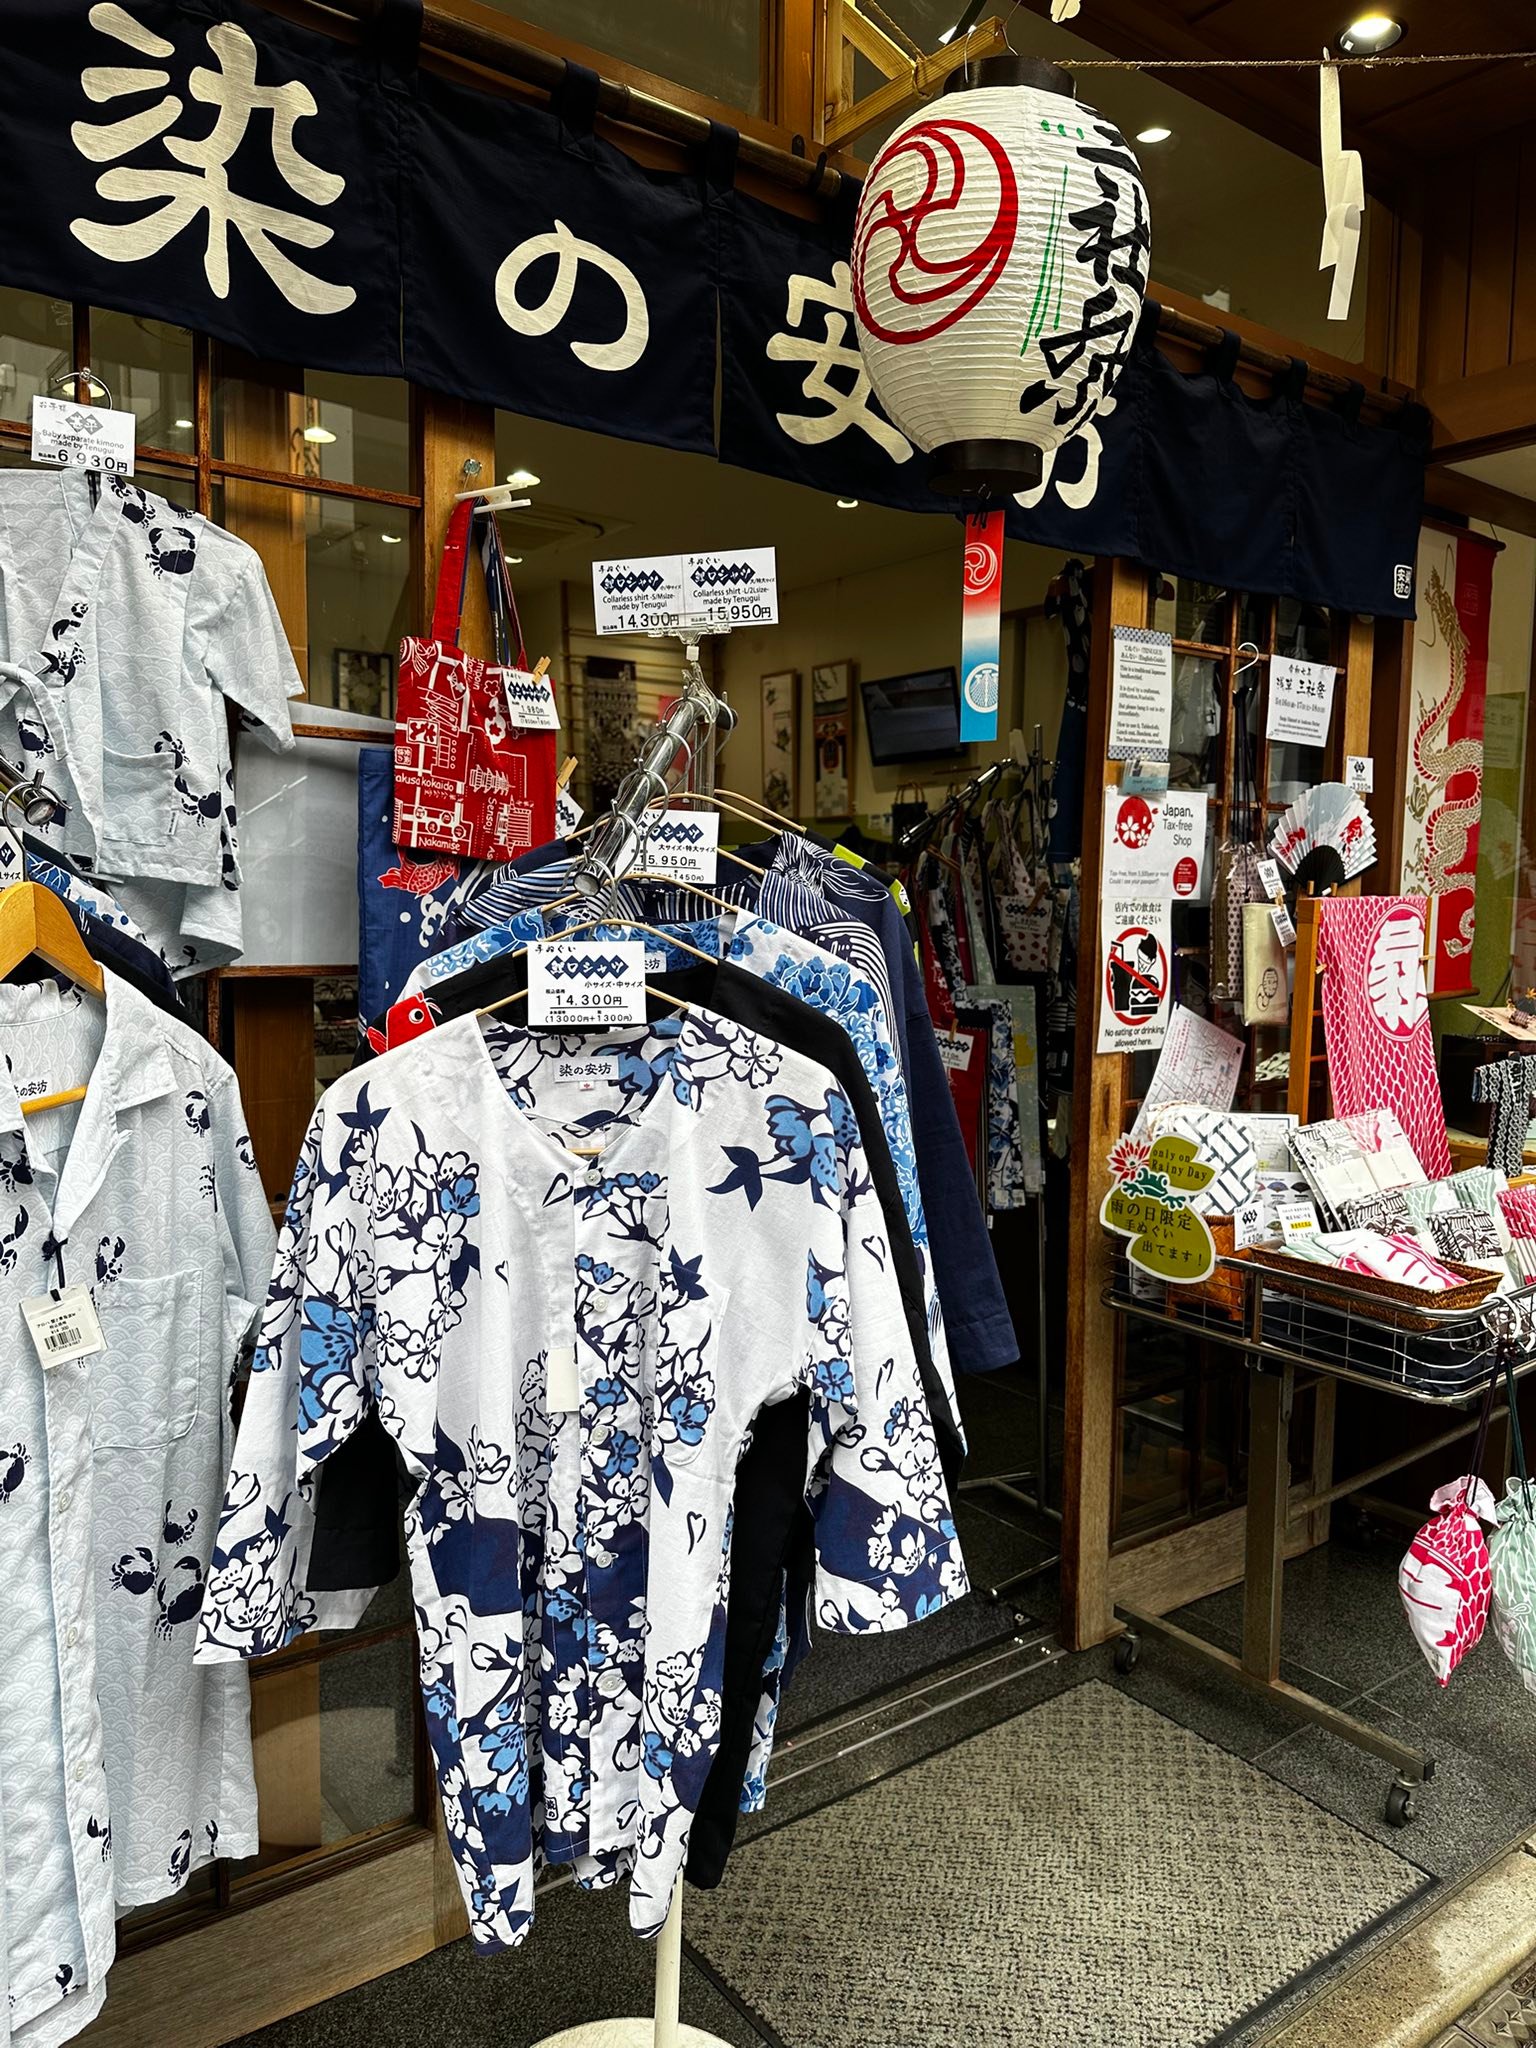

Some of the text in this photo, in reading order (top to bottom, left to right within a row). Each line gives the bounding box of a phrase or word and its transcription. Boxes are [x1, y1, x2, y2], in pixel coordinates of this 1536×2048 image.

[51, 439, 72, 447] made
[74, 442, 84, 451] by
[63, 434, 96, 445] separate
[97, 438, 125, 450] kimono
[603, 593, 633, 604] Collarless
[634, 592, 649, 602] shirt
[693, 588, 727, 598] Collarless
[727, 587, 741, 597] shirt
[612, 600, 667, 611] made by Tenugui
[703, 595, 760, 606] made by Tenugui
[421, 776, 454, 792] kokaido
[483, 796, 498, 834] Sensoji
[1162, 818, 1193, 832] Tax-free
[418, 836, 461, 851] Nakamise
[1173, 833, 1193, 849] Shop
[584, 980, 644, 990] 小サイズ・中サイズ
[1105, 1025, 1165, 1038] No eating or drinking
[1114, 1037, 1153, 1048] allowed here.
[558, 1062, 613, 1077] 染の安坊
[1153, 1149, 1191, 1164] only on
[1151, 1160, 1208, 1182] Rainy Day
[1111, 1198, 1192, 1232] 雨の日限定
[1126, 1218, 1174, 1239] 手ぬぐい
[1142, 1241, 1202, 1267] 出てます！
